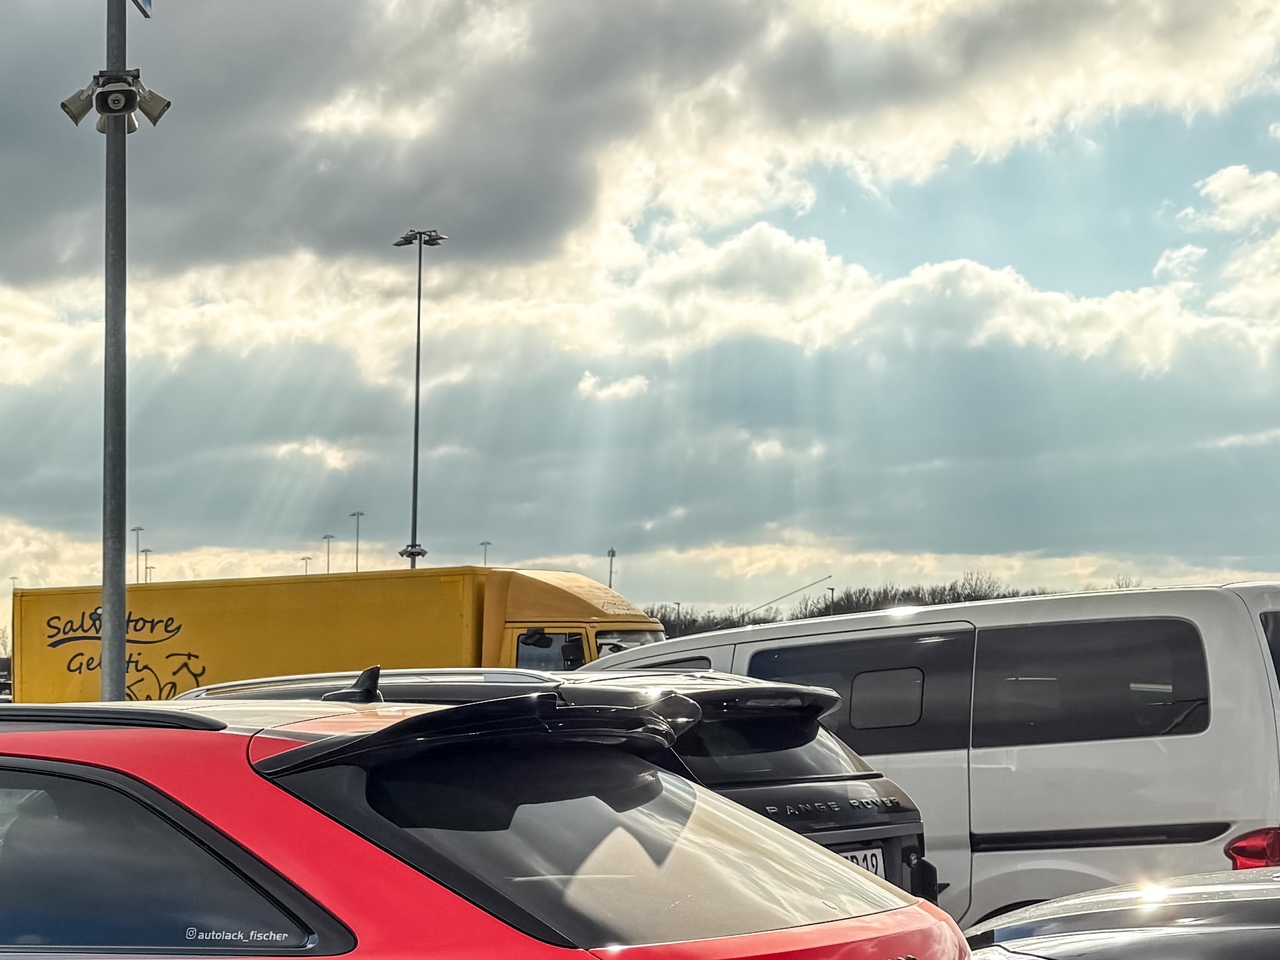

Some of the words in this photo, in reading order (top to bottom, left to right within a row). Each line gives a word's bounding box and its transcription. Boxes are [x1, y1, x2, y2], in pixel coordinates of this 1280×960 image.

[46, 607, 182, 639] Salvtore
[766, 802, 840, 815] RANGE
[849, 797, 901, 810] ROVER
[198, 931, 288, 942] autolack_fischer
